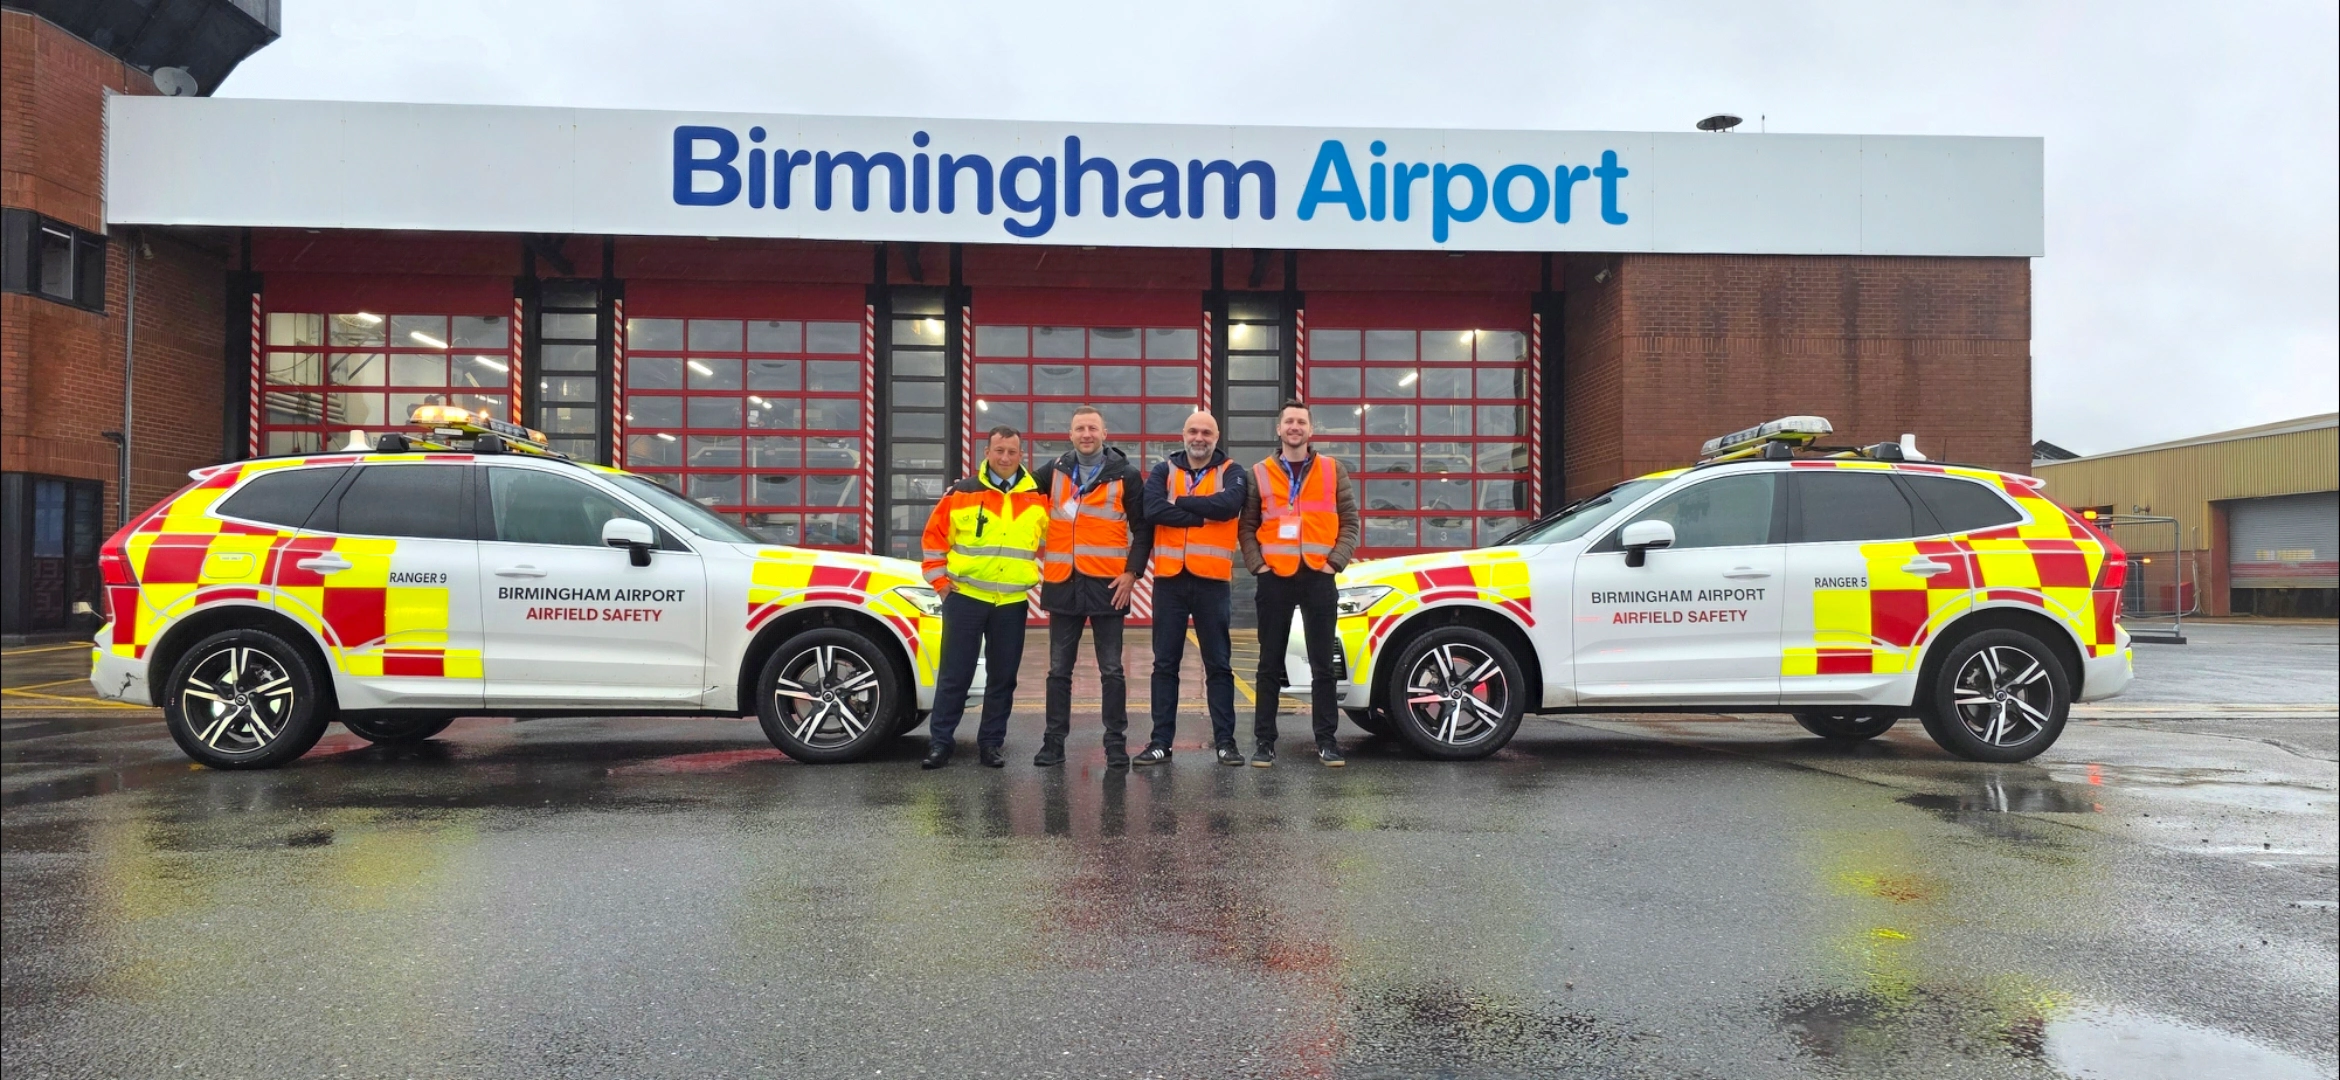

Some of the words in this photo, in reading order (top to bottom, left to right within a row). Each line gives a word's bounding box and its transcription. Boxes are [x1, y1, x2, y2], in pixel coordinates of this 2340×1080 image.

[673, 126, 1276, 237] Birmingham
[1297, 139, 1629, 244] Airport
[786, 526, 794, 536] 5
[1440, 532, 1448, 541] 3
[389, 572, 438, 584] RANGER
[439, 573, 448, 584] 9
[1814, 577, 1858, 588] RANGER
[1859, 576, 1868, 588] 5
[498, 586, 611, 602] BIRMINGHAM
[614, 588, 686, 602] AIRPORT
[1591, 590, 1693, 604] BIRMINGHAM
[1697, 588, 1766, 602] AIRPORT
[526, 606, 599, 621] AIRFIELD
[602, 608, 662, 622] SAFETY
[1612, 610, 1684, 625] AIRFIELD
[1687, 609, 1748, 623] SAFETY
